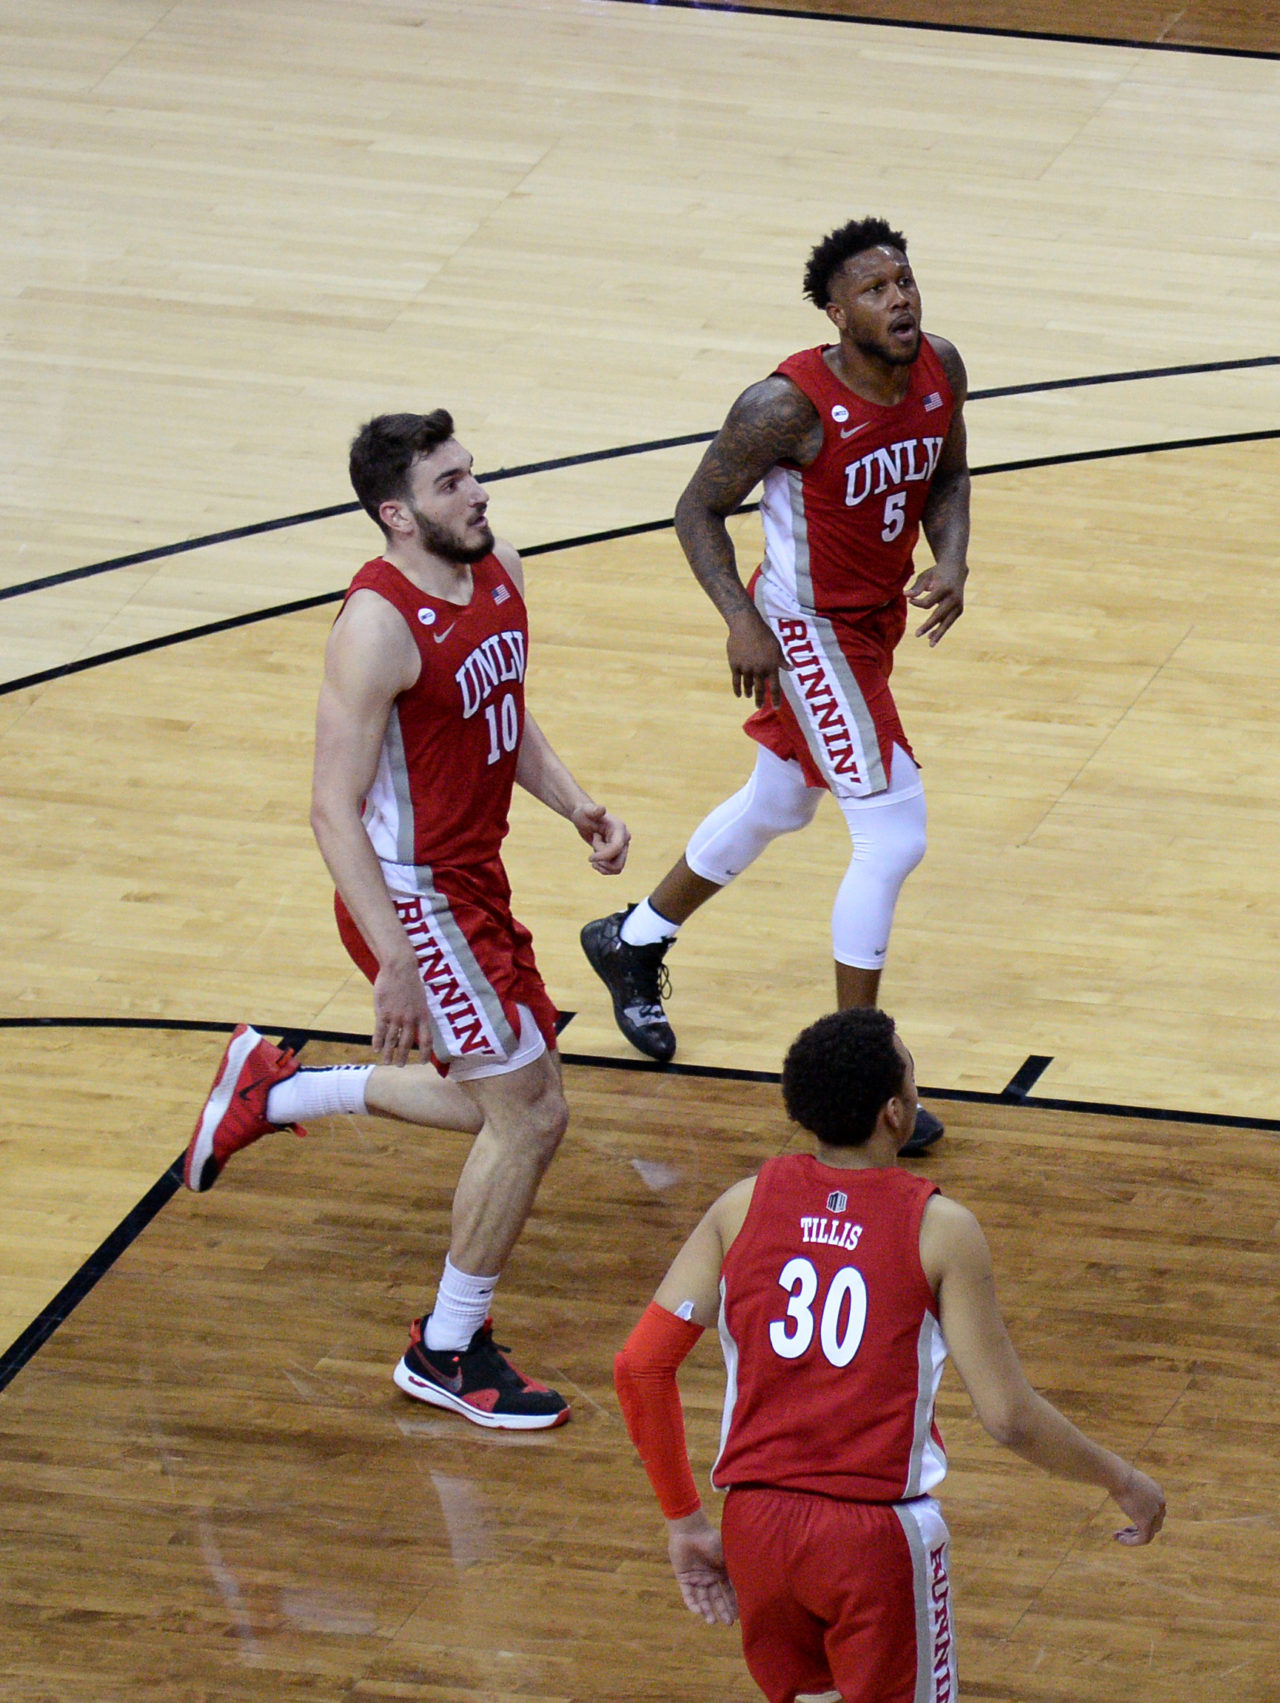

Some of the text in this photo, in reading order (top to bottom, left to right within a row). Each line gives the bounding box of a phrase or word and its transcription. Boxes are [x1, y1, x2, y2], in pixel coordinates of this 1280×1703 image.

[845, 437, 943, 506] UNLV
[881, 491, 907, 542] 5
[455, 630, 524, 719] UNLV
[485, 693, 518, 765] 10
[800, 1217, 863, 1250] TILLIS
[769, 1257, 867, 1368] 30
